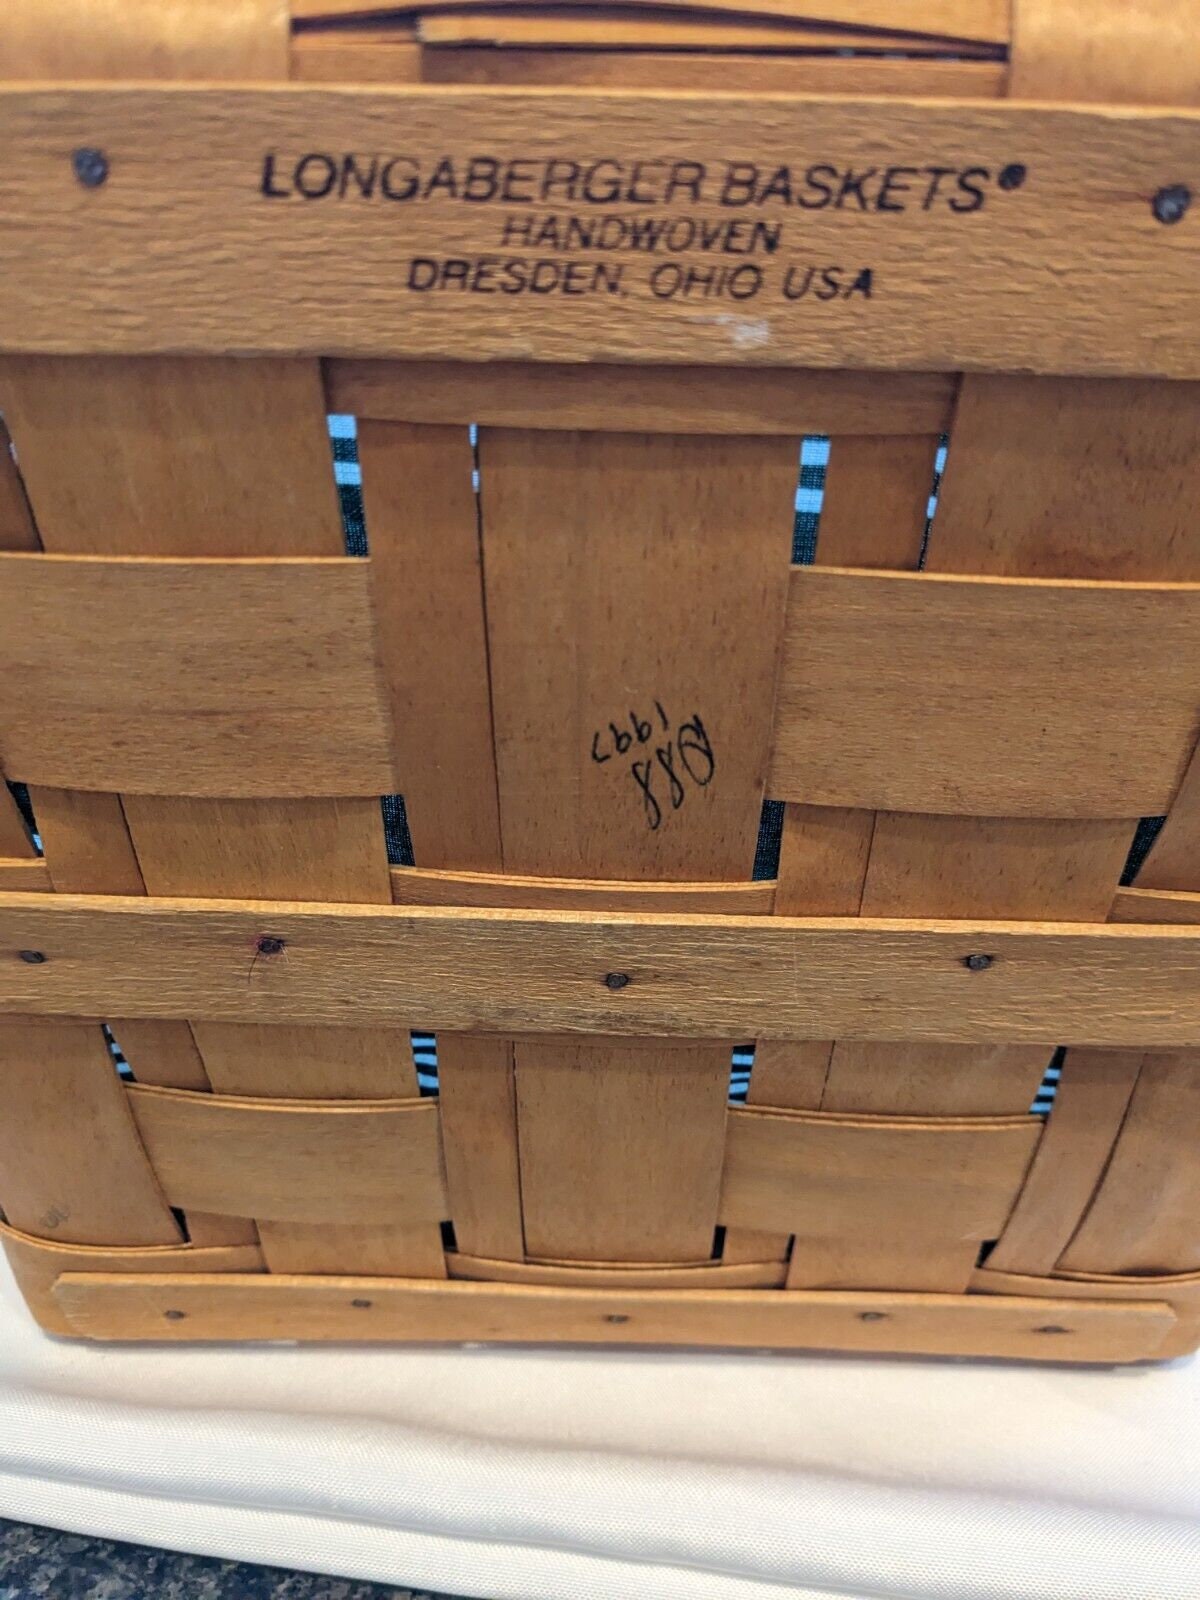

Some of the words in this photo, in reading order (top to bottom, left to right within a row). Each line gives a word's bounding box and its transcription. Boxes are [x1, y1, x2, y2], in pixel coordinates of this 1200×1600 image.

[260, 152, 706, 205] LONGABERGER
[500, 215, 781, 254] HANDWOVEN
[649, 262, 763, 300] OHIO
[782, 266, 875, 300] USA
[591, 700, 669, 763] 1997
